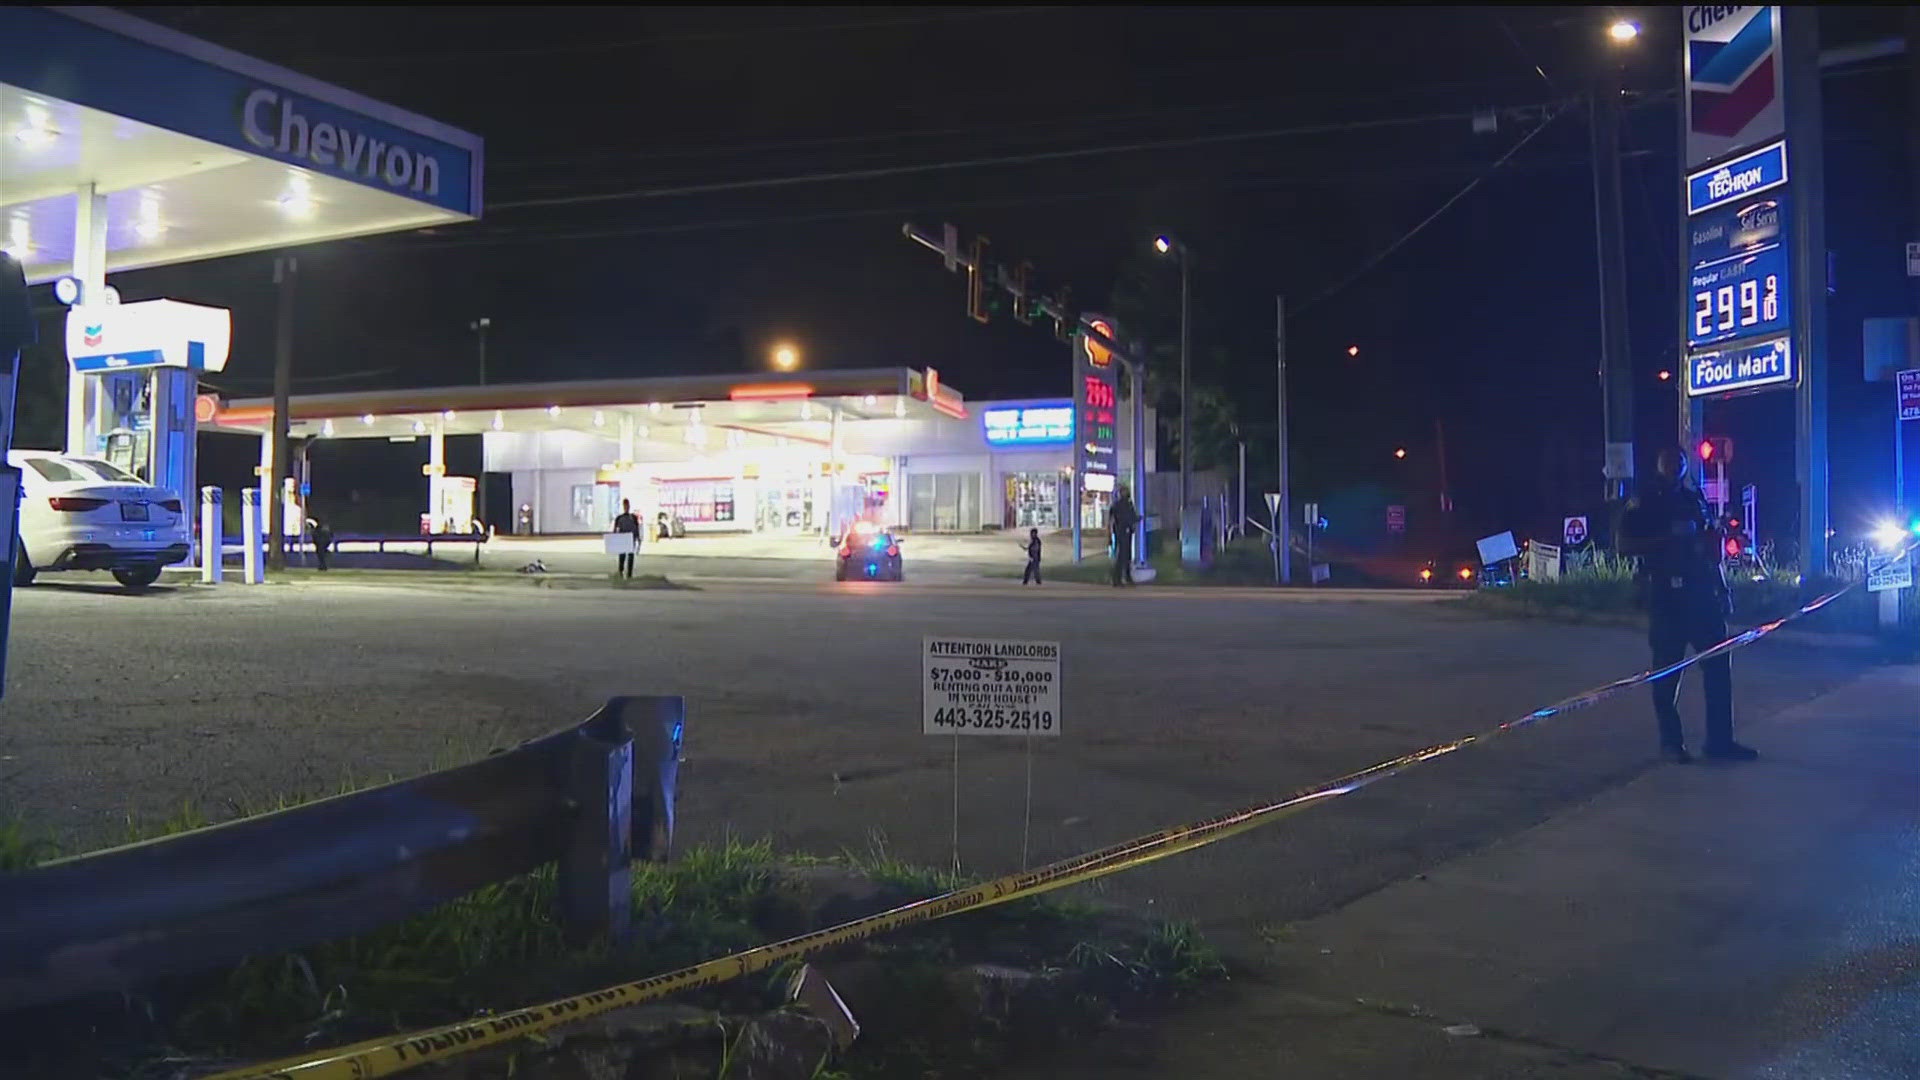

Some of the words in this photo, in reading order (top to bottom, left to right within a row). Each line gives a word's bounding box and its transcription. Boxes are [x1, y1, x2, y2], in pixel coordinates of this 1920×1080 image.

[243, 88, 439, 196] Chevron
[1707, 166, 1762, 200] TECHRON
[1696, 280, 1757, 336] 299
[1696, 359, 1732, 385] Food
[1738, 350, 1778, 378] Mart
[930, 641, 991, 655] ATTENTION
[994, 643, 1057, 657] LANDLORDS
[931, 667, 981, 682] $7,000
[994, 670, 1053, 684] $10,000
[933, 681, 980, 693] RENTING
[982, 683, 1003, 694] OUT
[1005, 684, 1014, 694] A
[1015, 684, 1048, 695] ROOM
[948, 692, 959, 704] IN
[961, 692, 991, 704] YOUR
[934, 707, 1053, 731] 443-325-2519
